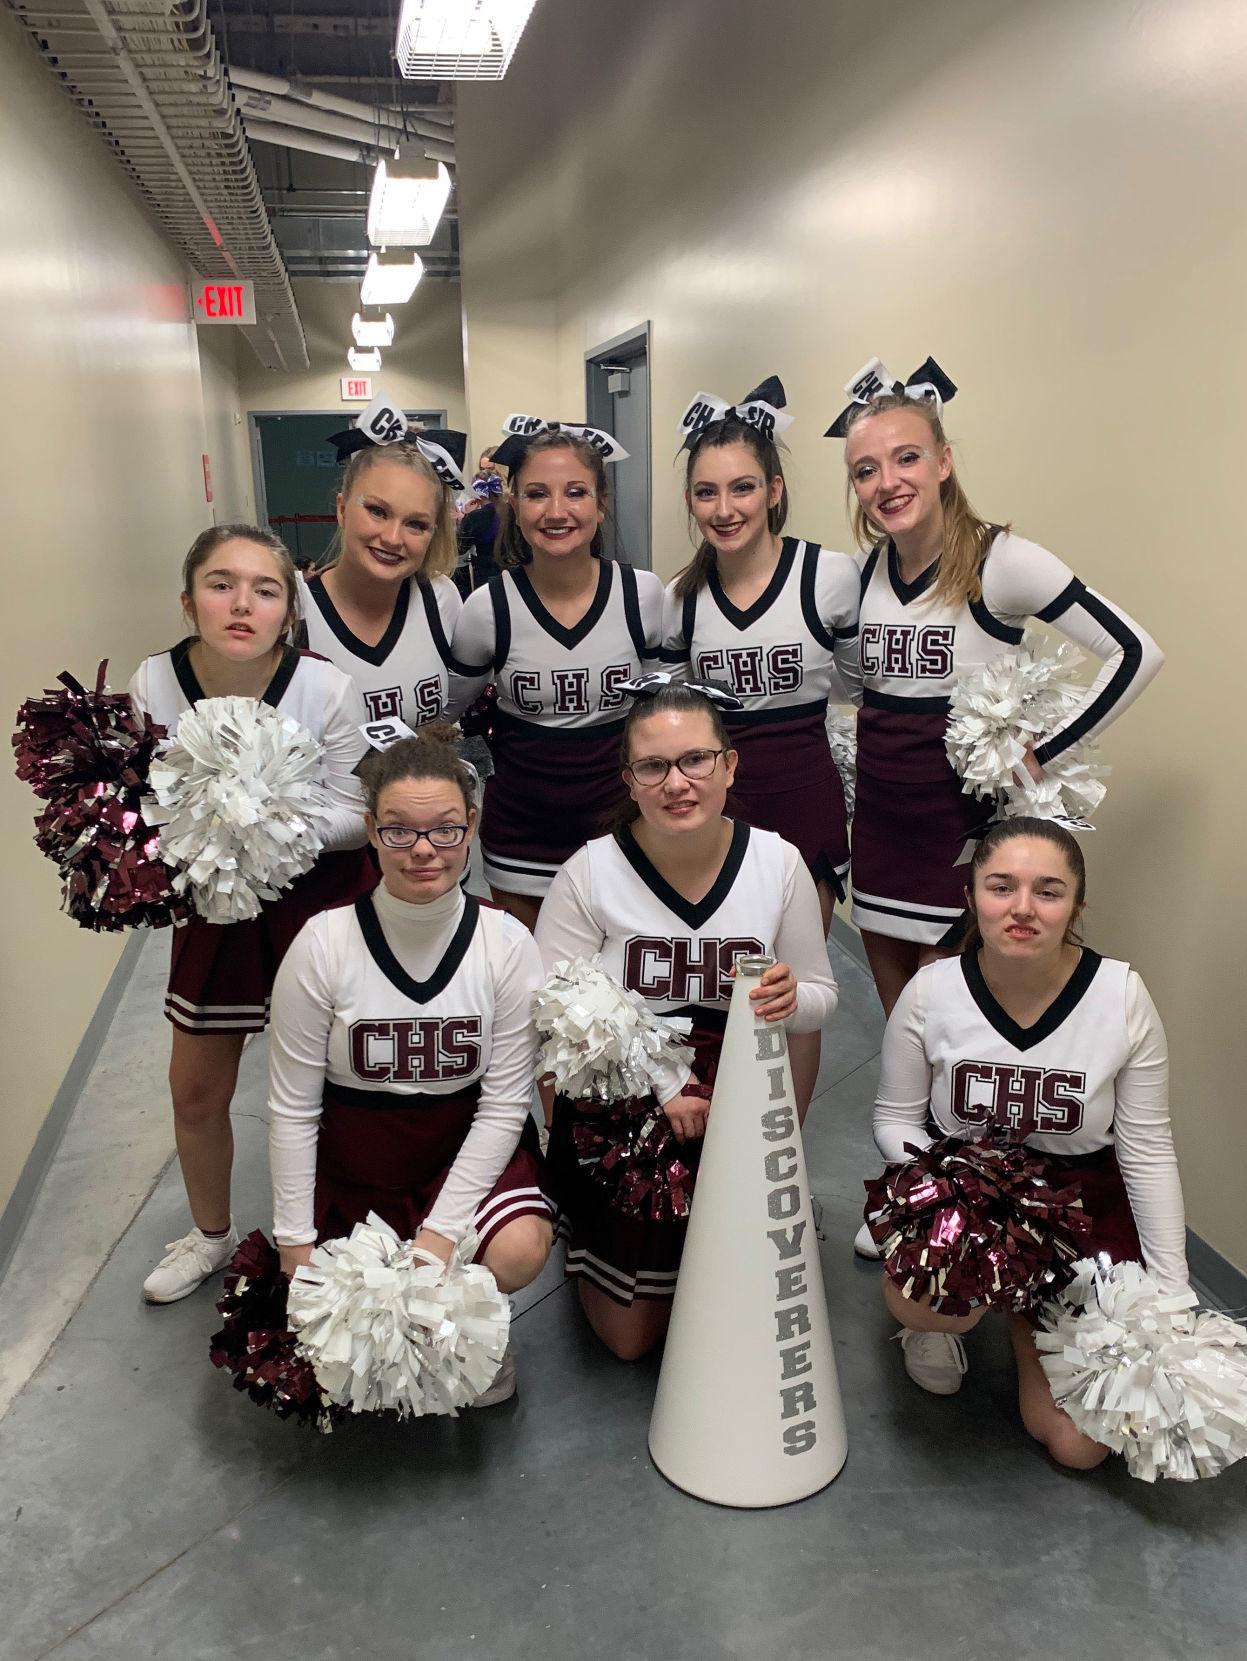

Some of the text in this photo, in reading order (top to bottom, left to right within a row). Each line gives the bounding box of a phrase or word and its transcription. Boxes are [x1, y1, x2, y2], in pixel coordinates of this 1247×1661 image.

[204, 285, 244, 318] EXIT
[347, 380, 367, 397] EXIT
[697, 643, 803, 697] CHS
[858, 623, 956, 679] CHS
[363, 674, 443, 728] HS
[509, 663, 632, 716] CHS
[349, 1015, 482, 1083] CHS
[951, 1059, 1086, 1135] CHS
[753, 1024, 818, 1457] DISCOVERERS
